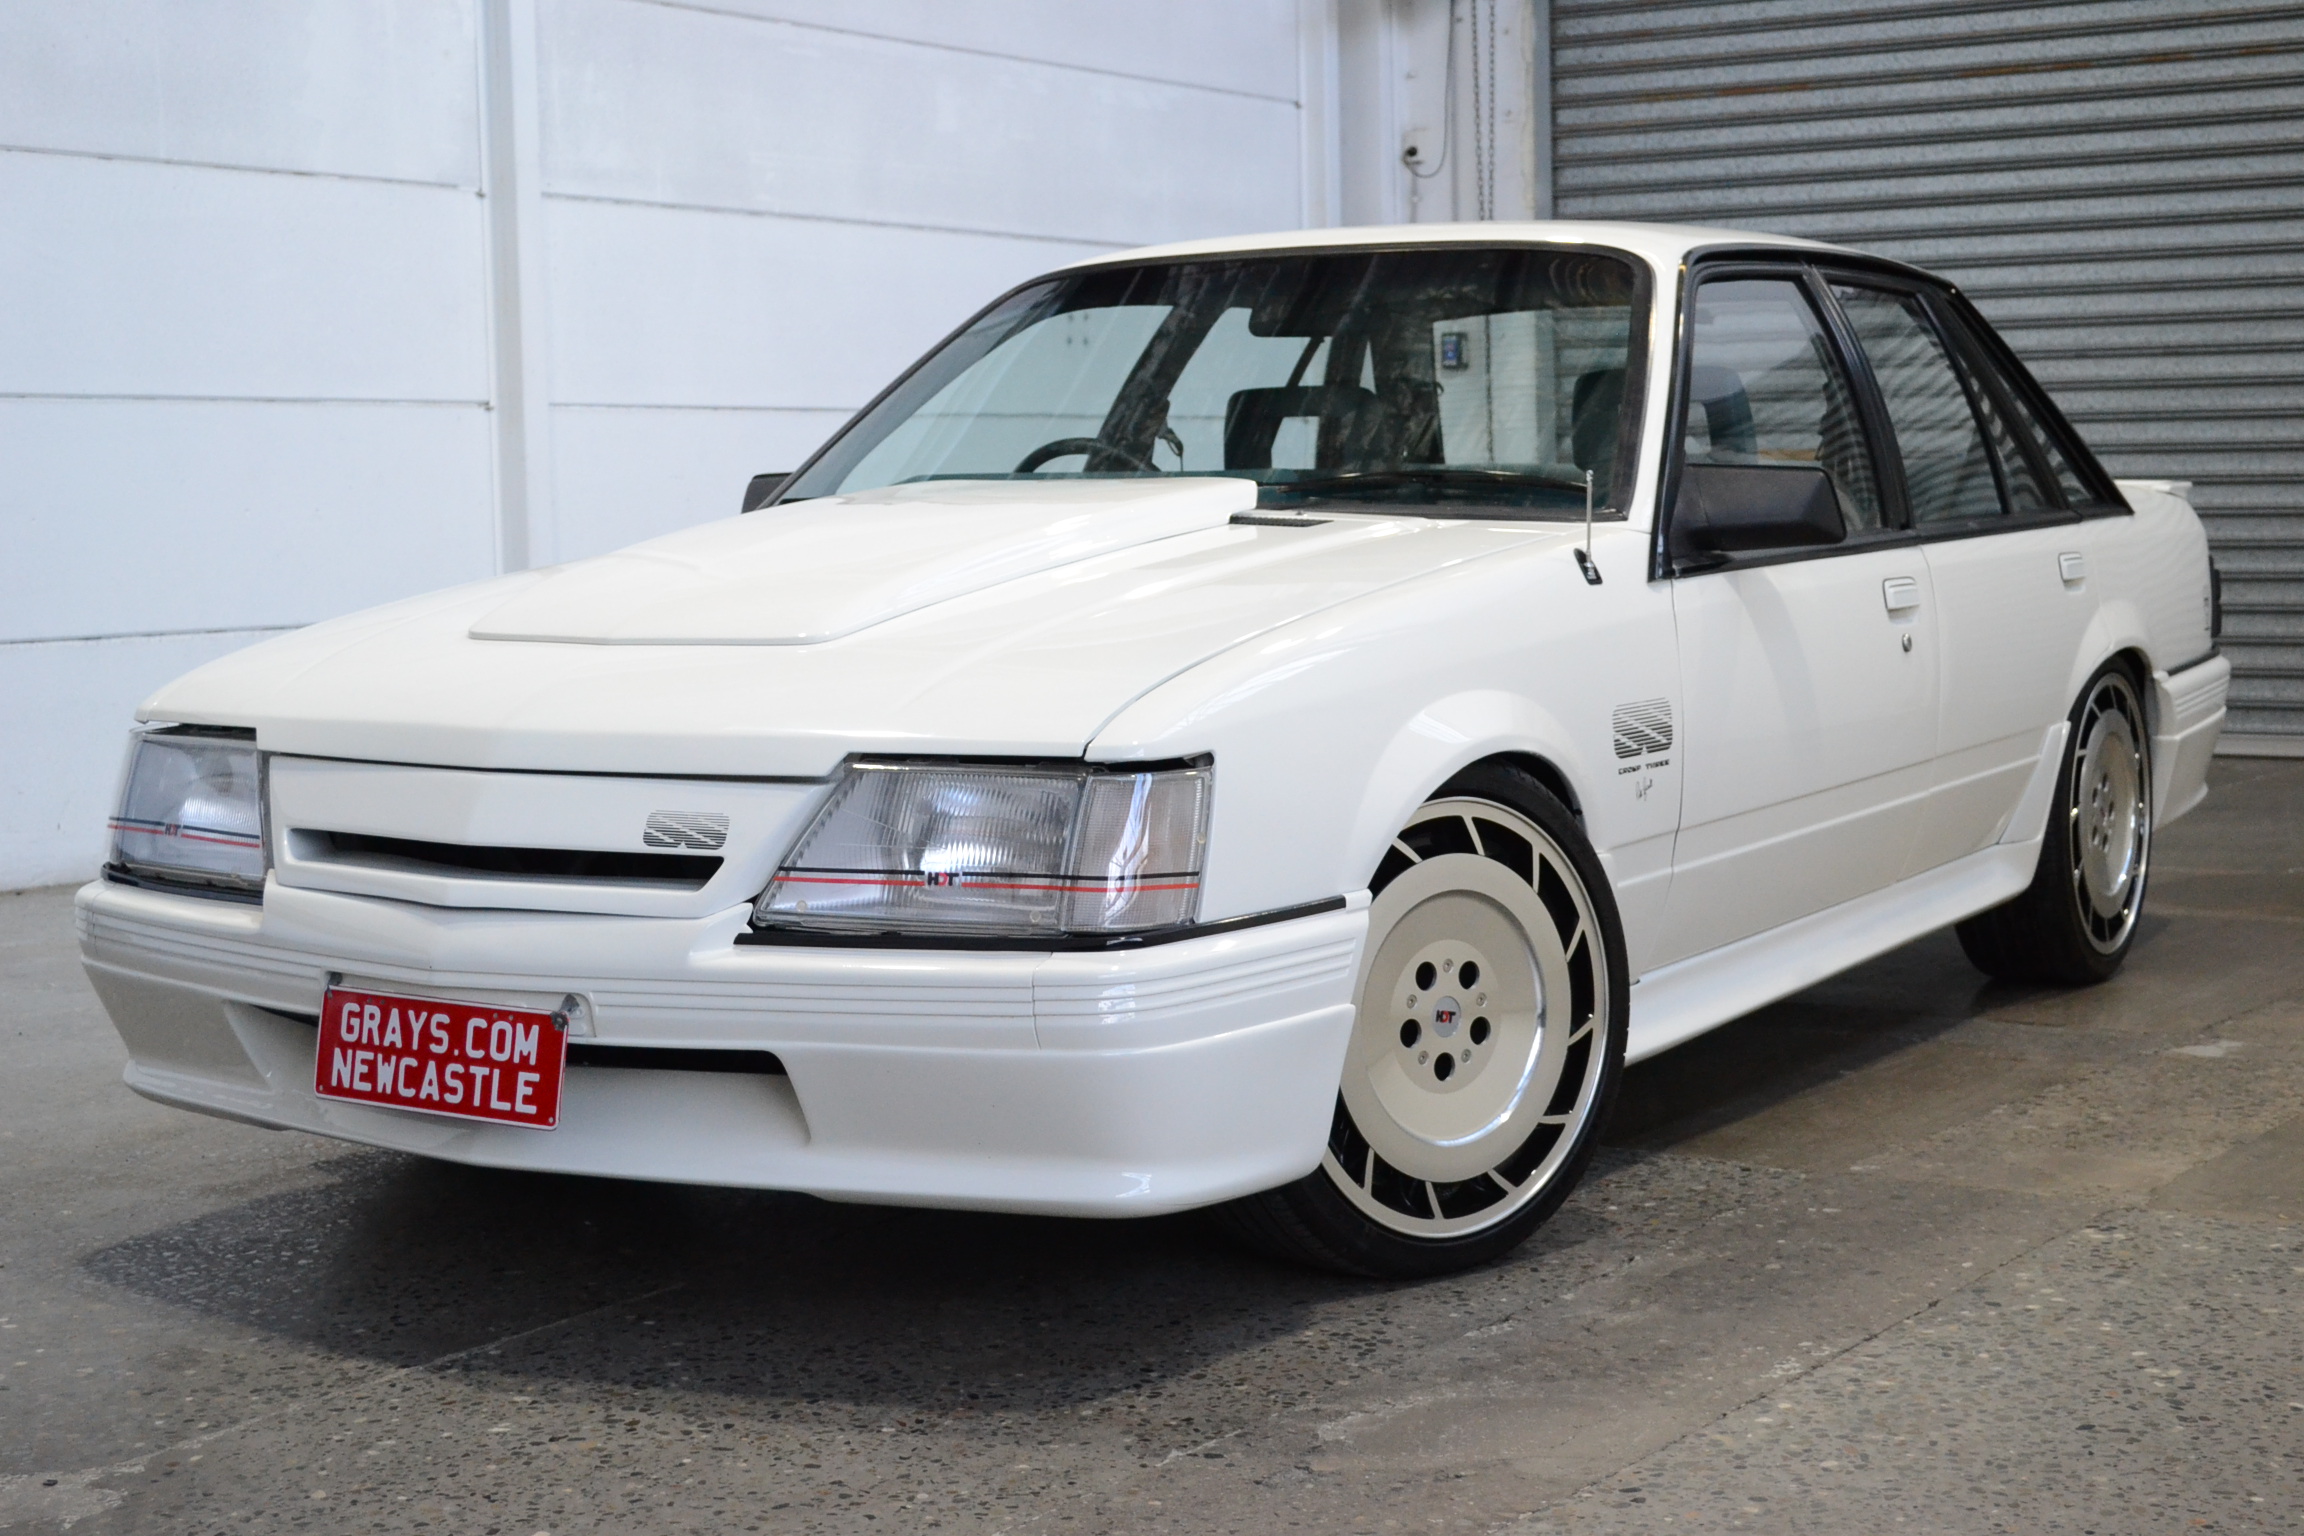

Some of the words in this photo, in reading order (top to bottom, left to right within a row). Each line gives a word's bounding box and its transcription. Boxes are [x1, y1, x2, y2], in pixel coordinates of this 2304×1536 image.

[927, 872, 960, 887] HDT
[340, 1002, 540, 1066] GRAYS.COM
[1435, 1009, 1457, 1024] HDT
[331, 1047, 541, 1115] NEWCASTLE
